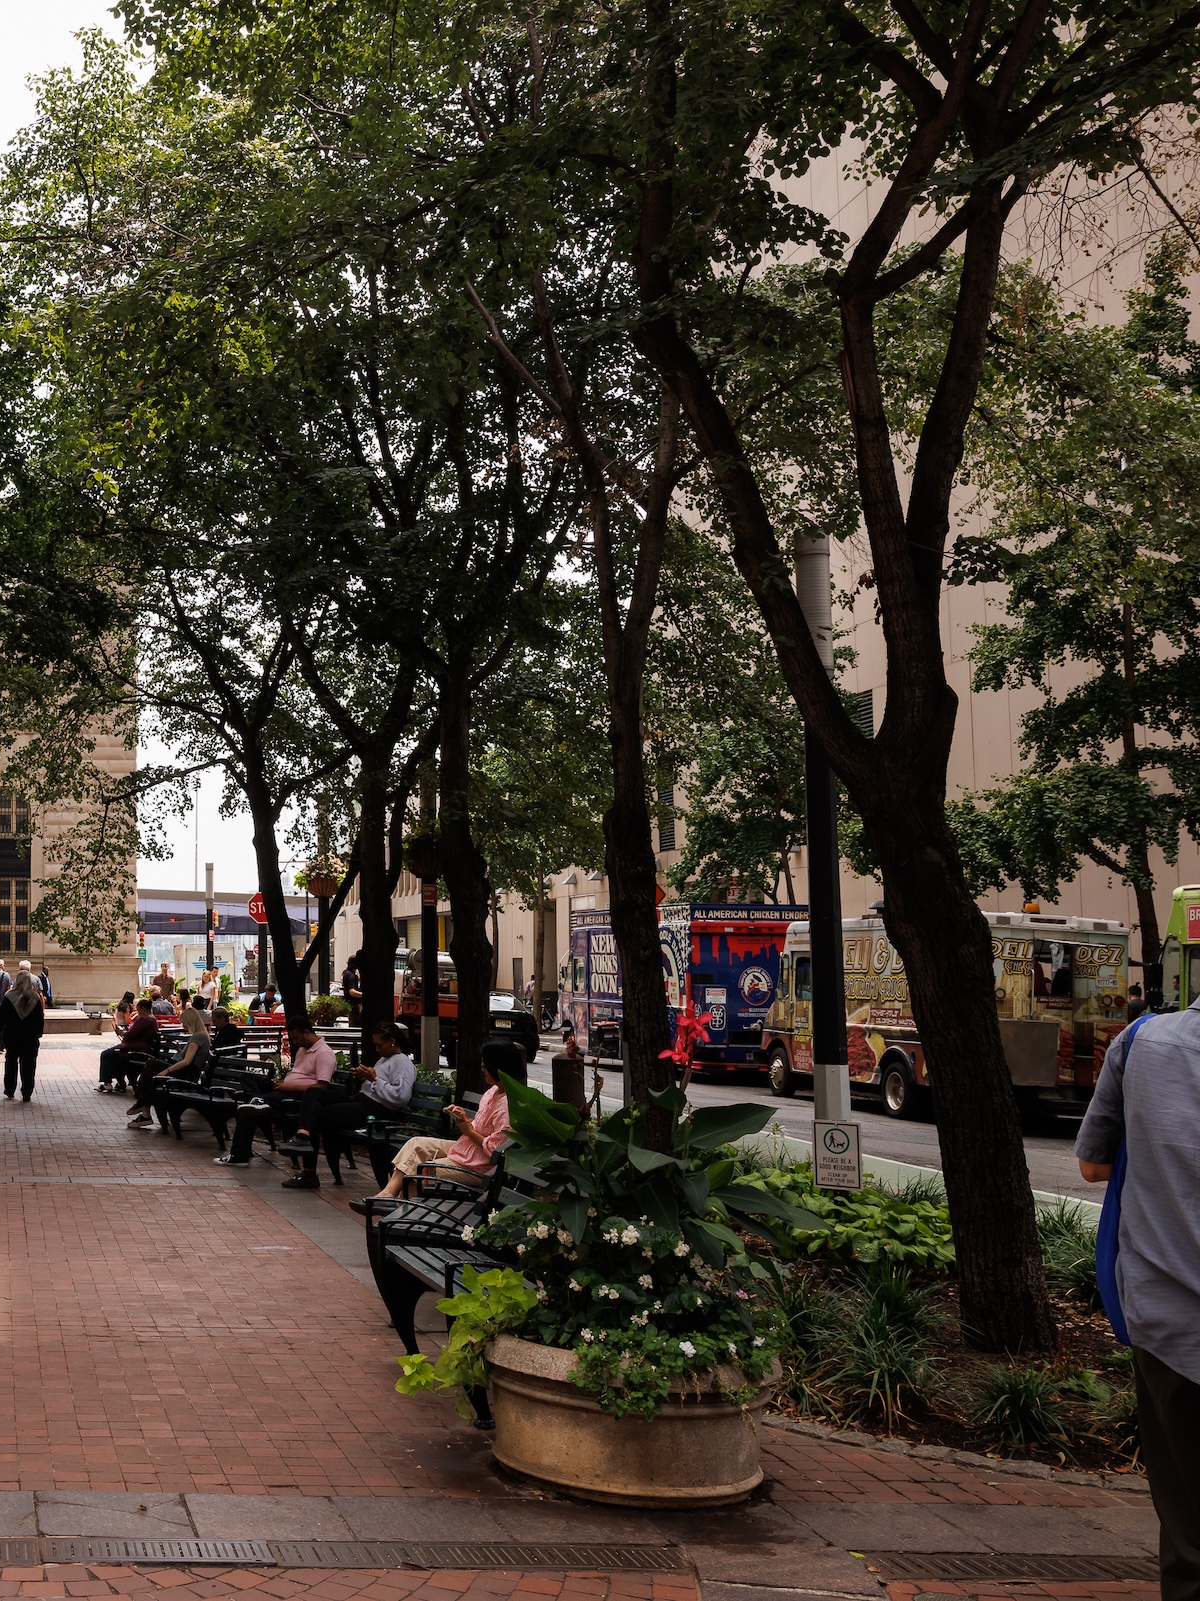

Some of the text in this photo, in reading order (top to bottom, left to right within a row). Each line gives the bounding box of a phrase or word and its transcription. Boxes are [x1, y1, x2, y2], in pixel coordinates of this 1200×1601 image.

[250, 902, 266, 914] ST
[693, 909, 707, 918] ALL
[707, 909, 748, 919] AMERICAN
[750, 910, 780, 920] CHICKEN
[590, 934, 617, 953] NEW
[843, 937, 871, 972] ELI
[590, 954, 618, 974] YORK'S
[590, 973, 618, 994] OWN
[822, 1156, 839, 1164] PLEASE
[833, 1164, 856, 1172] NEIGHBOR
